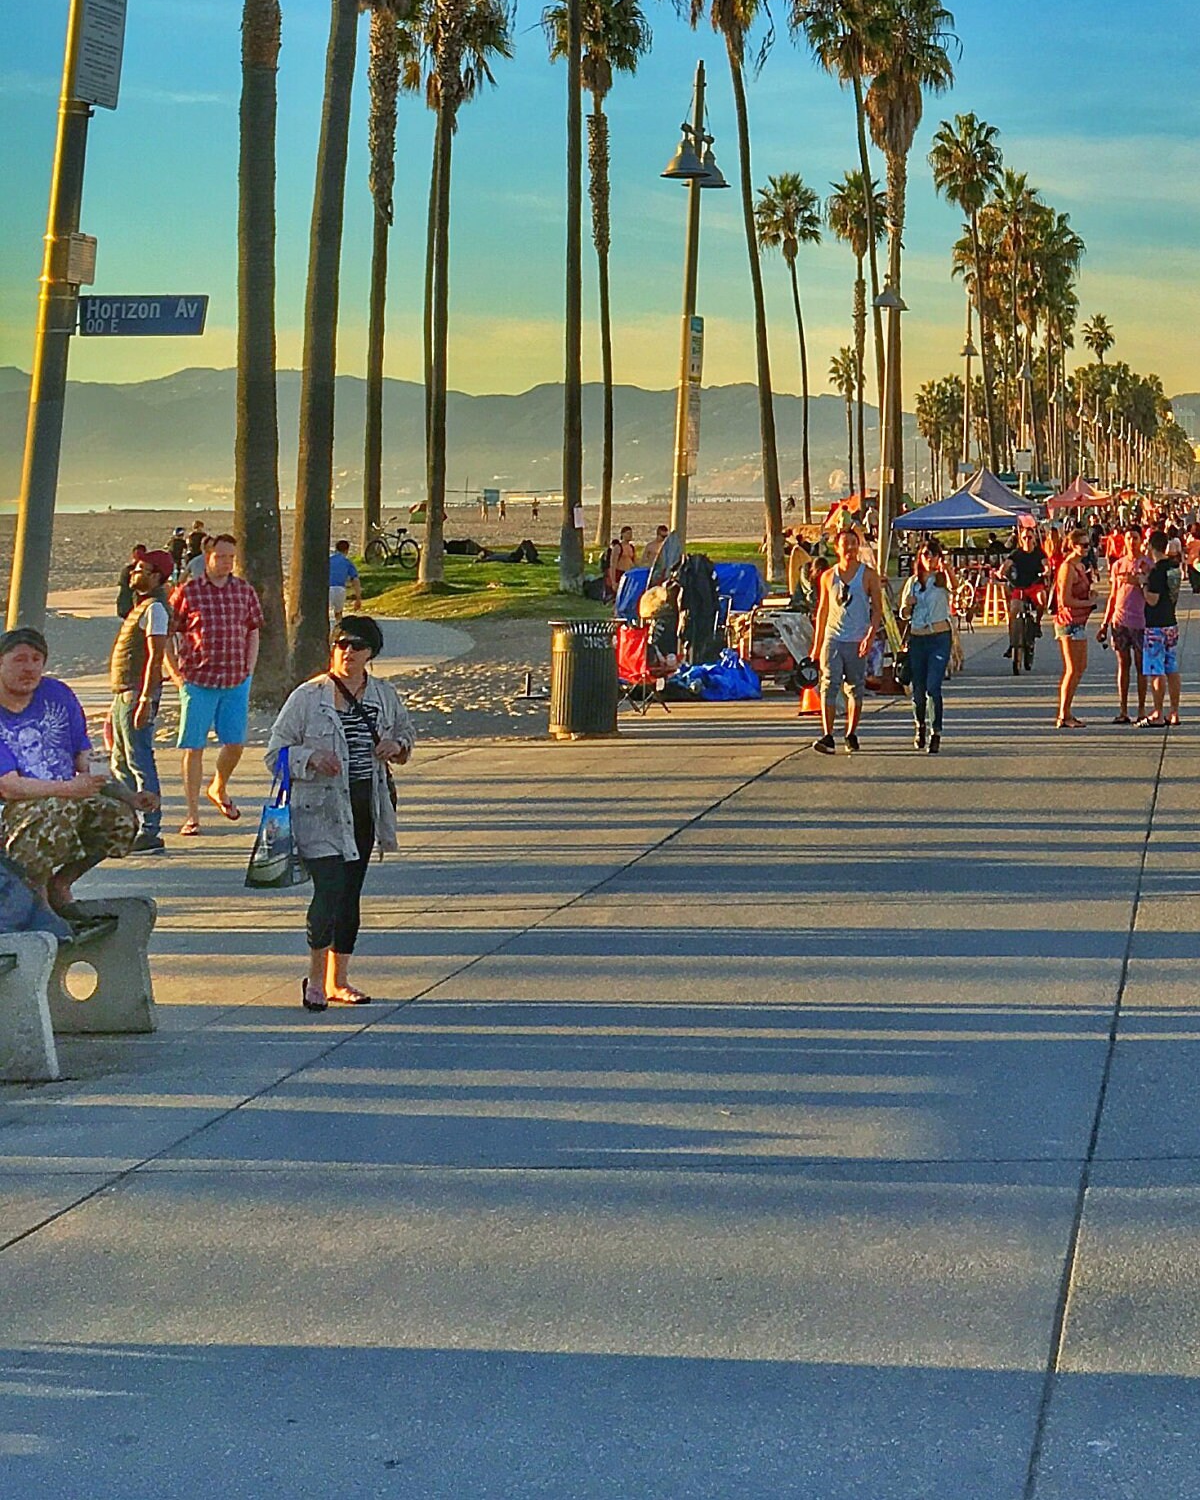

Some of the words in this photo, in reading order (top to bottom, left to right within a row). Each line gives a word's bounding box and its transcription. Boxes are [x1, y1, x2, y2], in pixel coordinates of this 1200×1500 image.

[86, 299, 161, 319] Horizon
[174, 298, 198, 319] Av
[86, 319, 104, 333] 00
[110, 319, 119, 333] E
